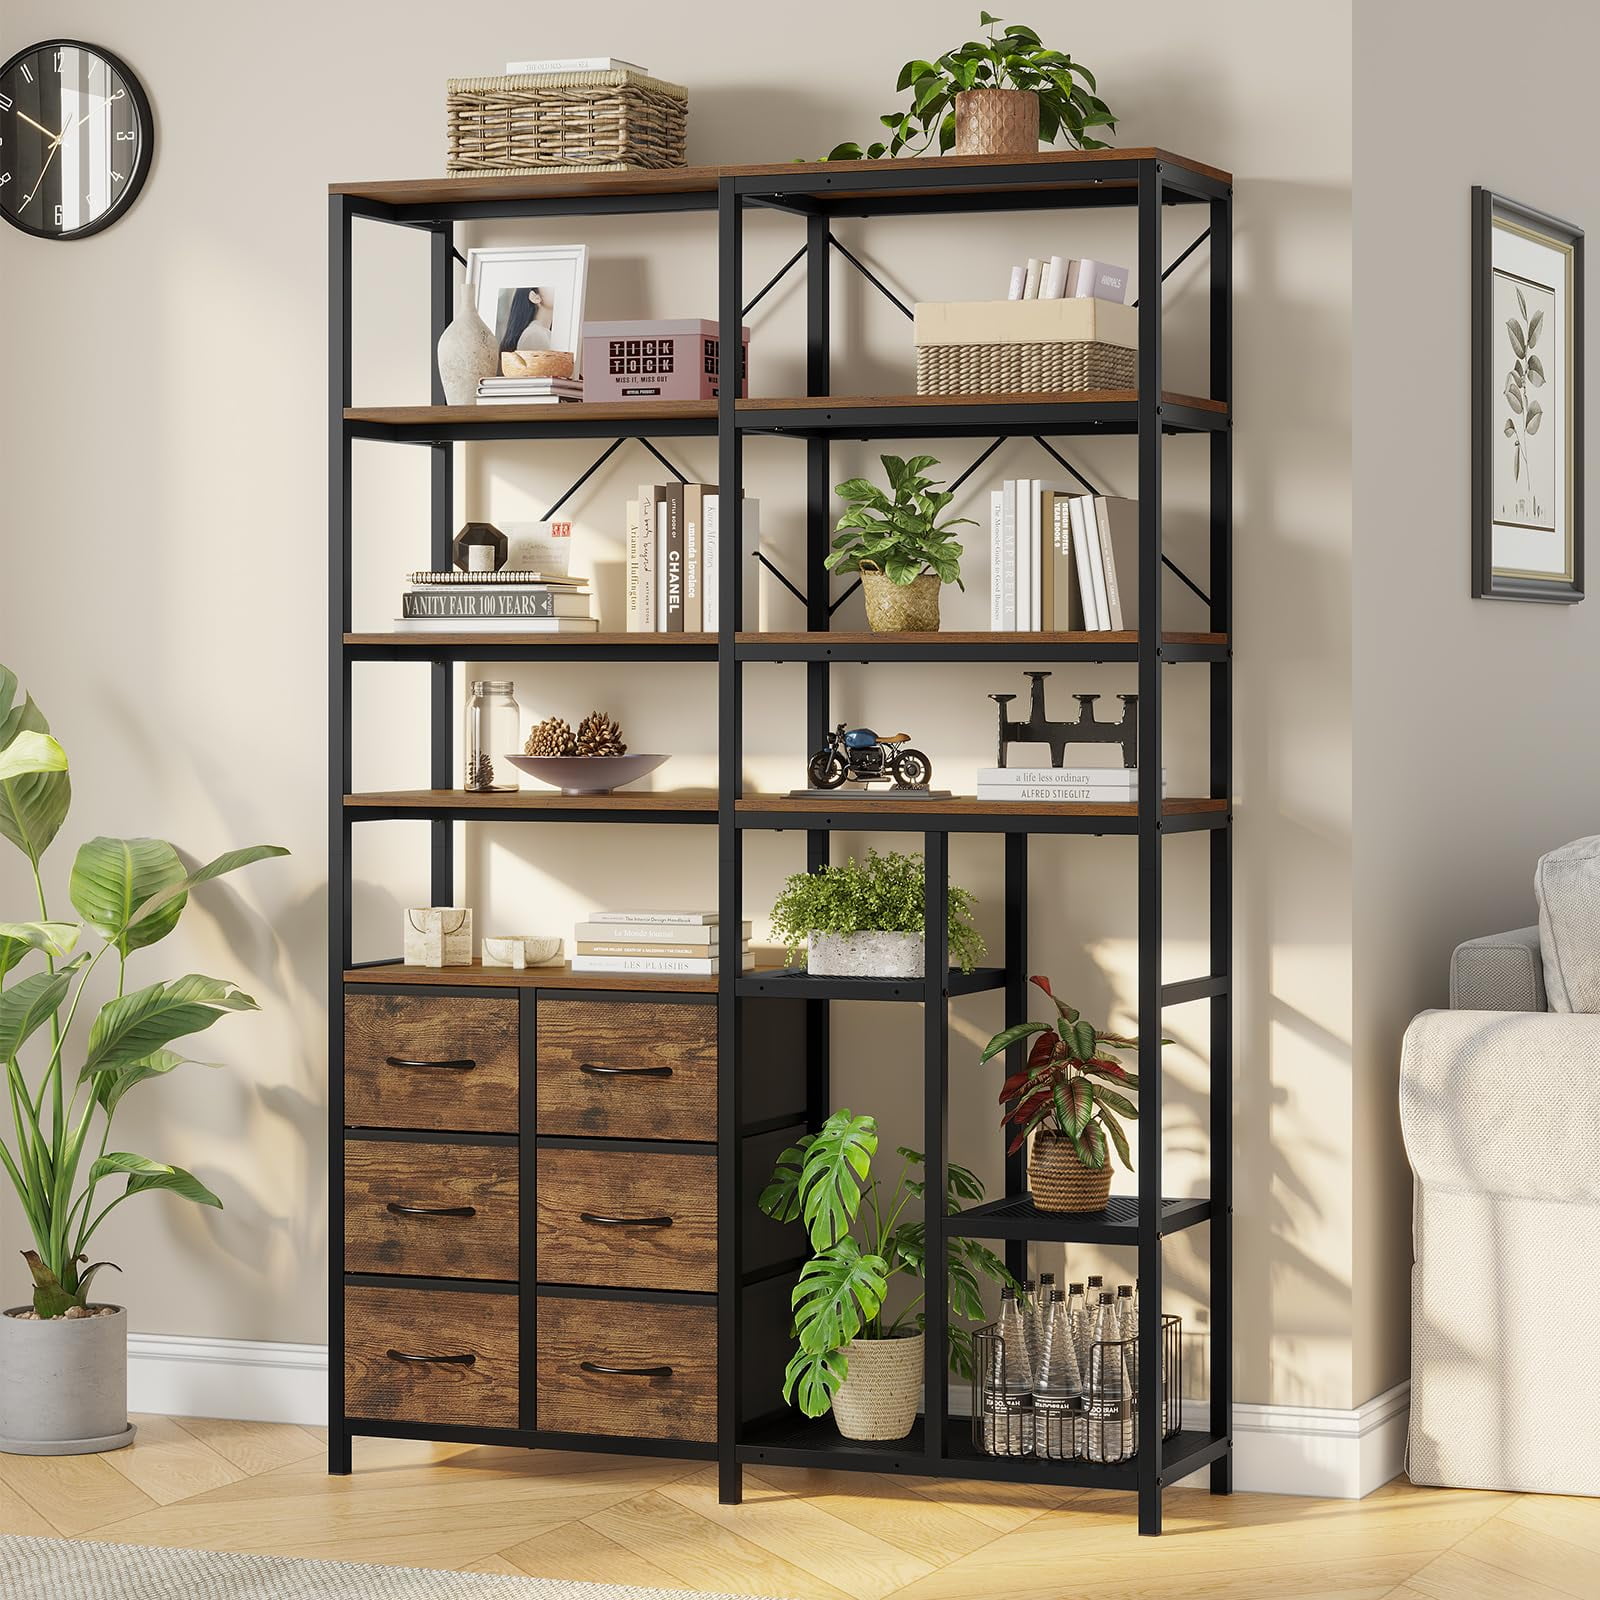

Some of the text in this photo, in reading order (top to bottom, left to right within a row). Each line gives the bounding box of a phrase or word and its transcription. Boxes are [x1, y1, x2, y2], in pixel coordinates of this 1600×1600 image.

[116, 131, 135, 141] 3
[613, 341, 671, 356] TICK
[613, 359, 671, 373] TOCK
[615, 376, 631, 384] MISS
[688, 522, 697, 598] amanda lovelace
[629, 524, 640, 611] Arianna Huffington
[669, 550, 680, 613] CHANEL
[404, 594, 536, 616] VANITY FAIR 100 YEARS
[1023, 773, 1036, 782] life
[1038, 773, 1053, 782] less
[1054, 773, 1090, 784] ordinary
[1021, 789, 1090, 799] ALFRED STIEGLITZ
[624, 960, 641, 969] LES
[645, 960, 690, 970] PLAISIRS
